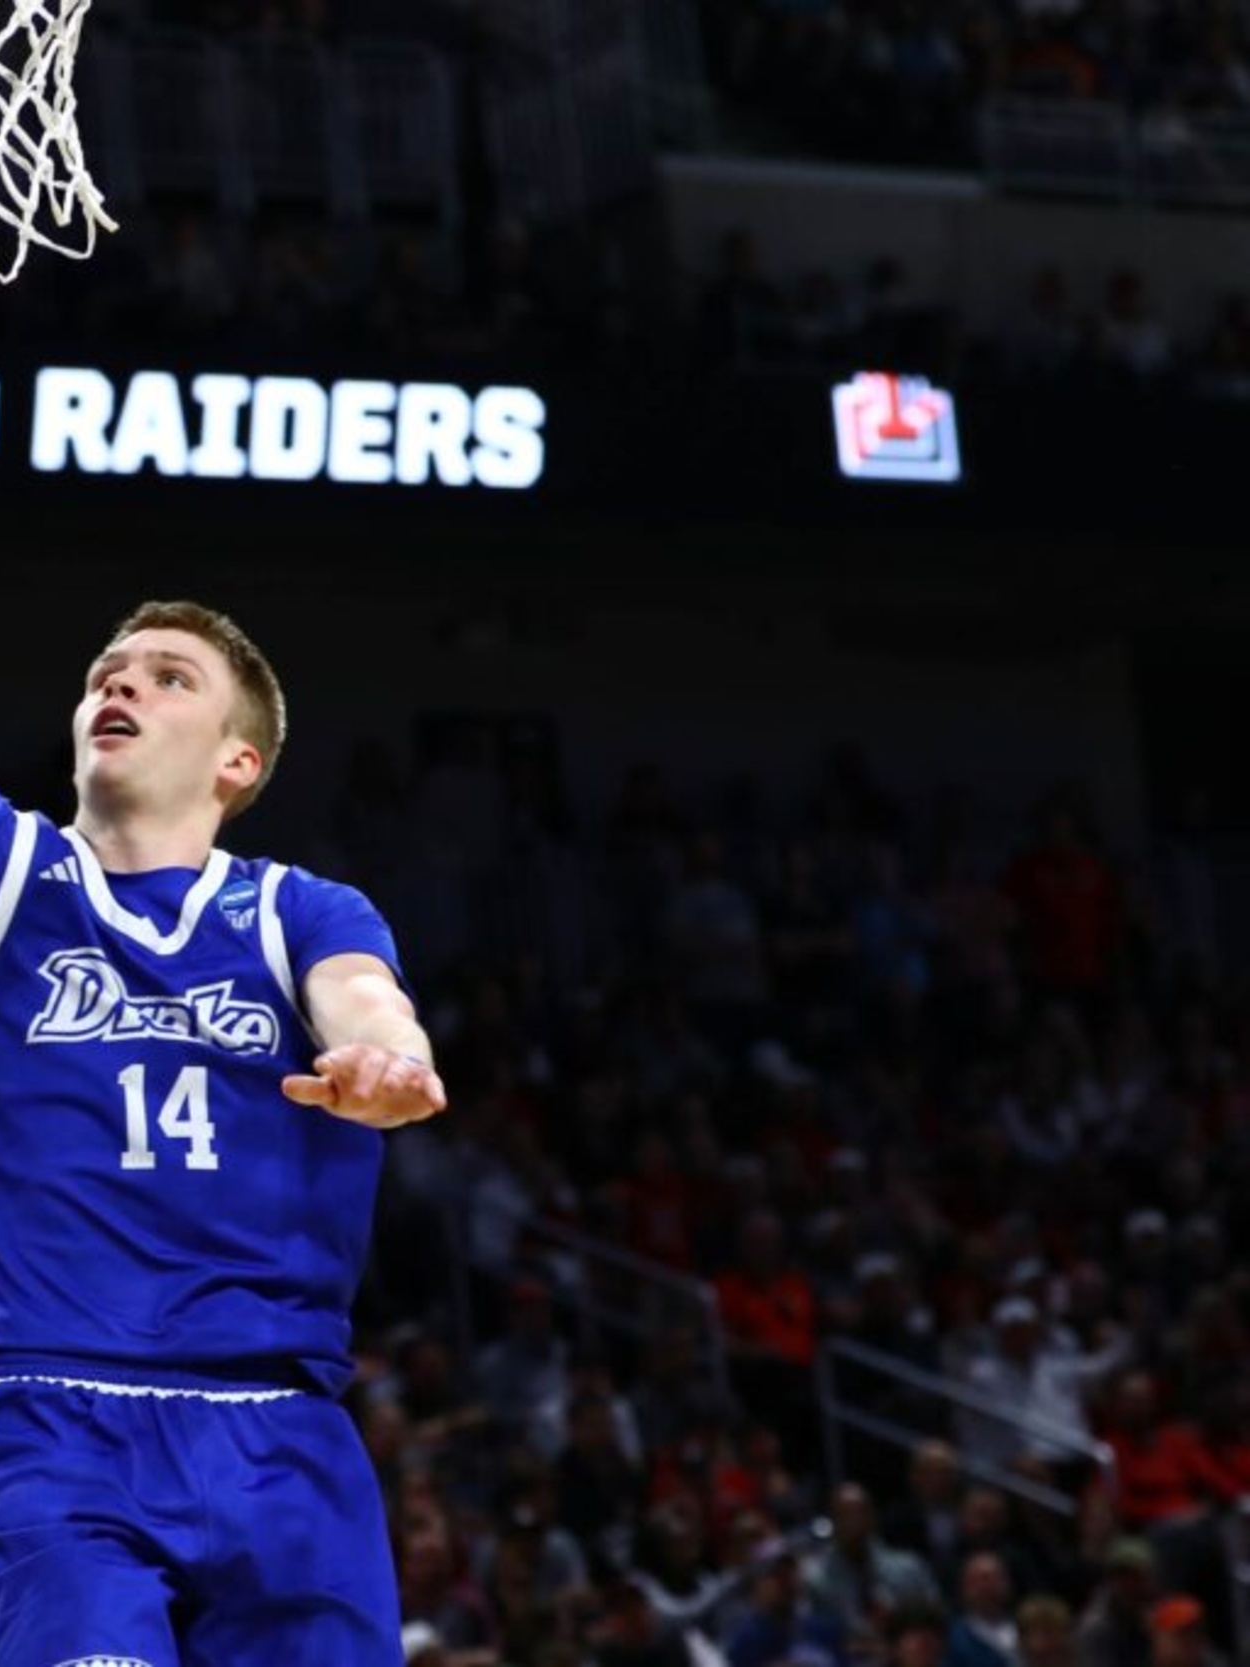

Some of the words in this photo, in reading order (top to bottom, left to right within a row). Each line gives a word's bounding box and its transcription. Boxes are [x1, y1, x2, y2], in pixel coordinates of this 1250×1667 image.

[30, 366, 546, 489] RAIDERS
[26, 946, 280, 1056] Drake
[117, 1063, 219, 1170] 14
